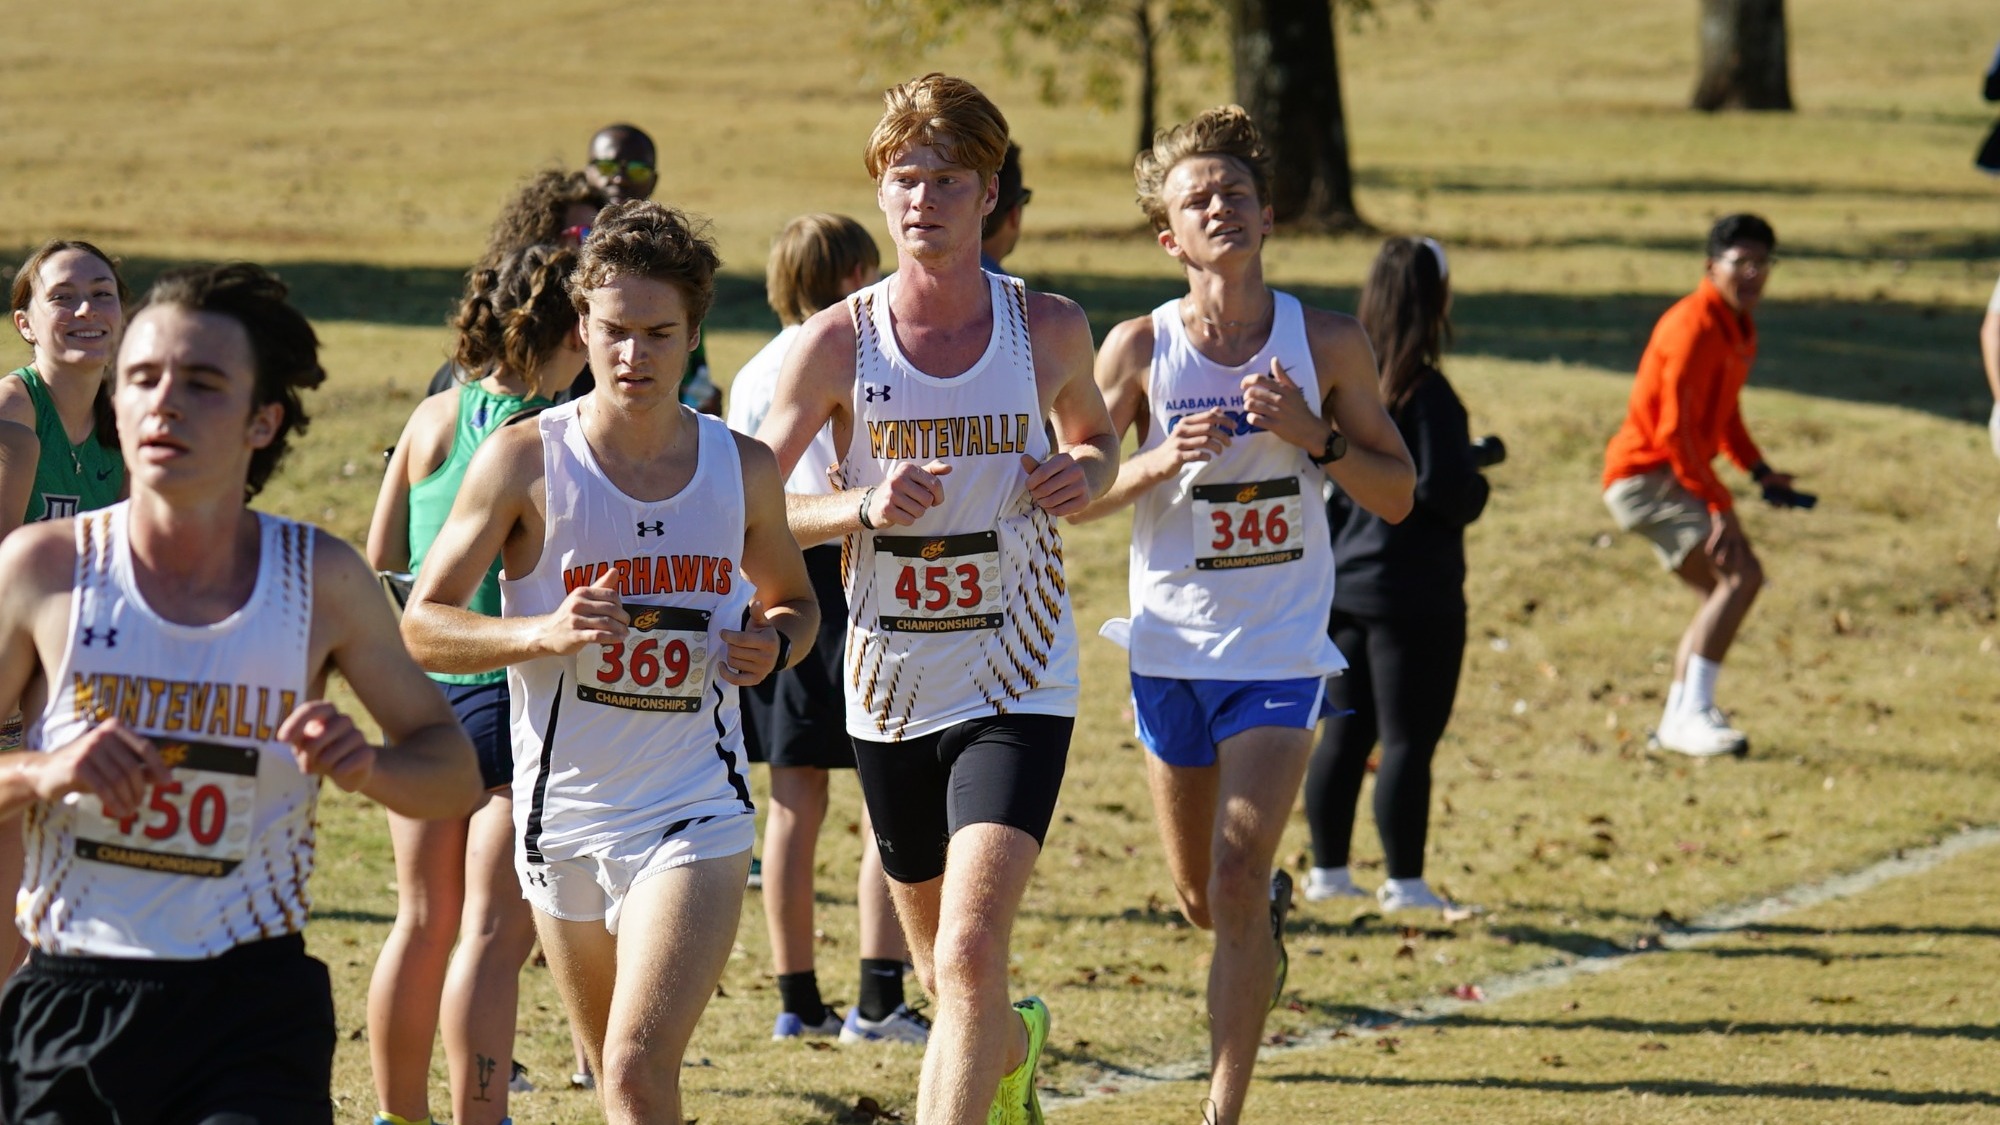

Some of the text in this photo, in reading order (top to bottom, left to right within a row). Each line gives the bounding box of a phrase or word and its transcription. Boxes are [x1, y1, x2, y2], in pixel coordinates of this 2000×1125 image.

[1166, 396, 1227, 411] ALABAMA
[867, 414, 1029, 460] MONTEVALLO
[1210, 504, 1289, 551] 346
[920, 540, 946, 559] GSC
[1212, 551, 1293, 569] CHAMPIONSHIPS
[895, 564, 982, 611] 453
[633, 610, 661, 629] GSC
[896, 617, 987, 631] CHAMPIONSHIPS
[596, 638, 690, 689] 369
[595, 691, 687, 711] CHAMPIONSHIPS
[97, 846, 226, 876] CHAMPIONSHIPS
